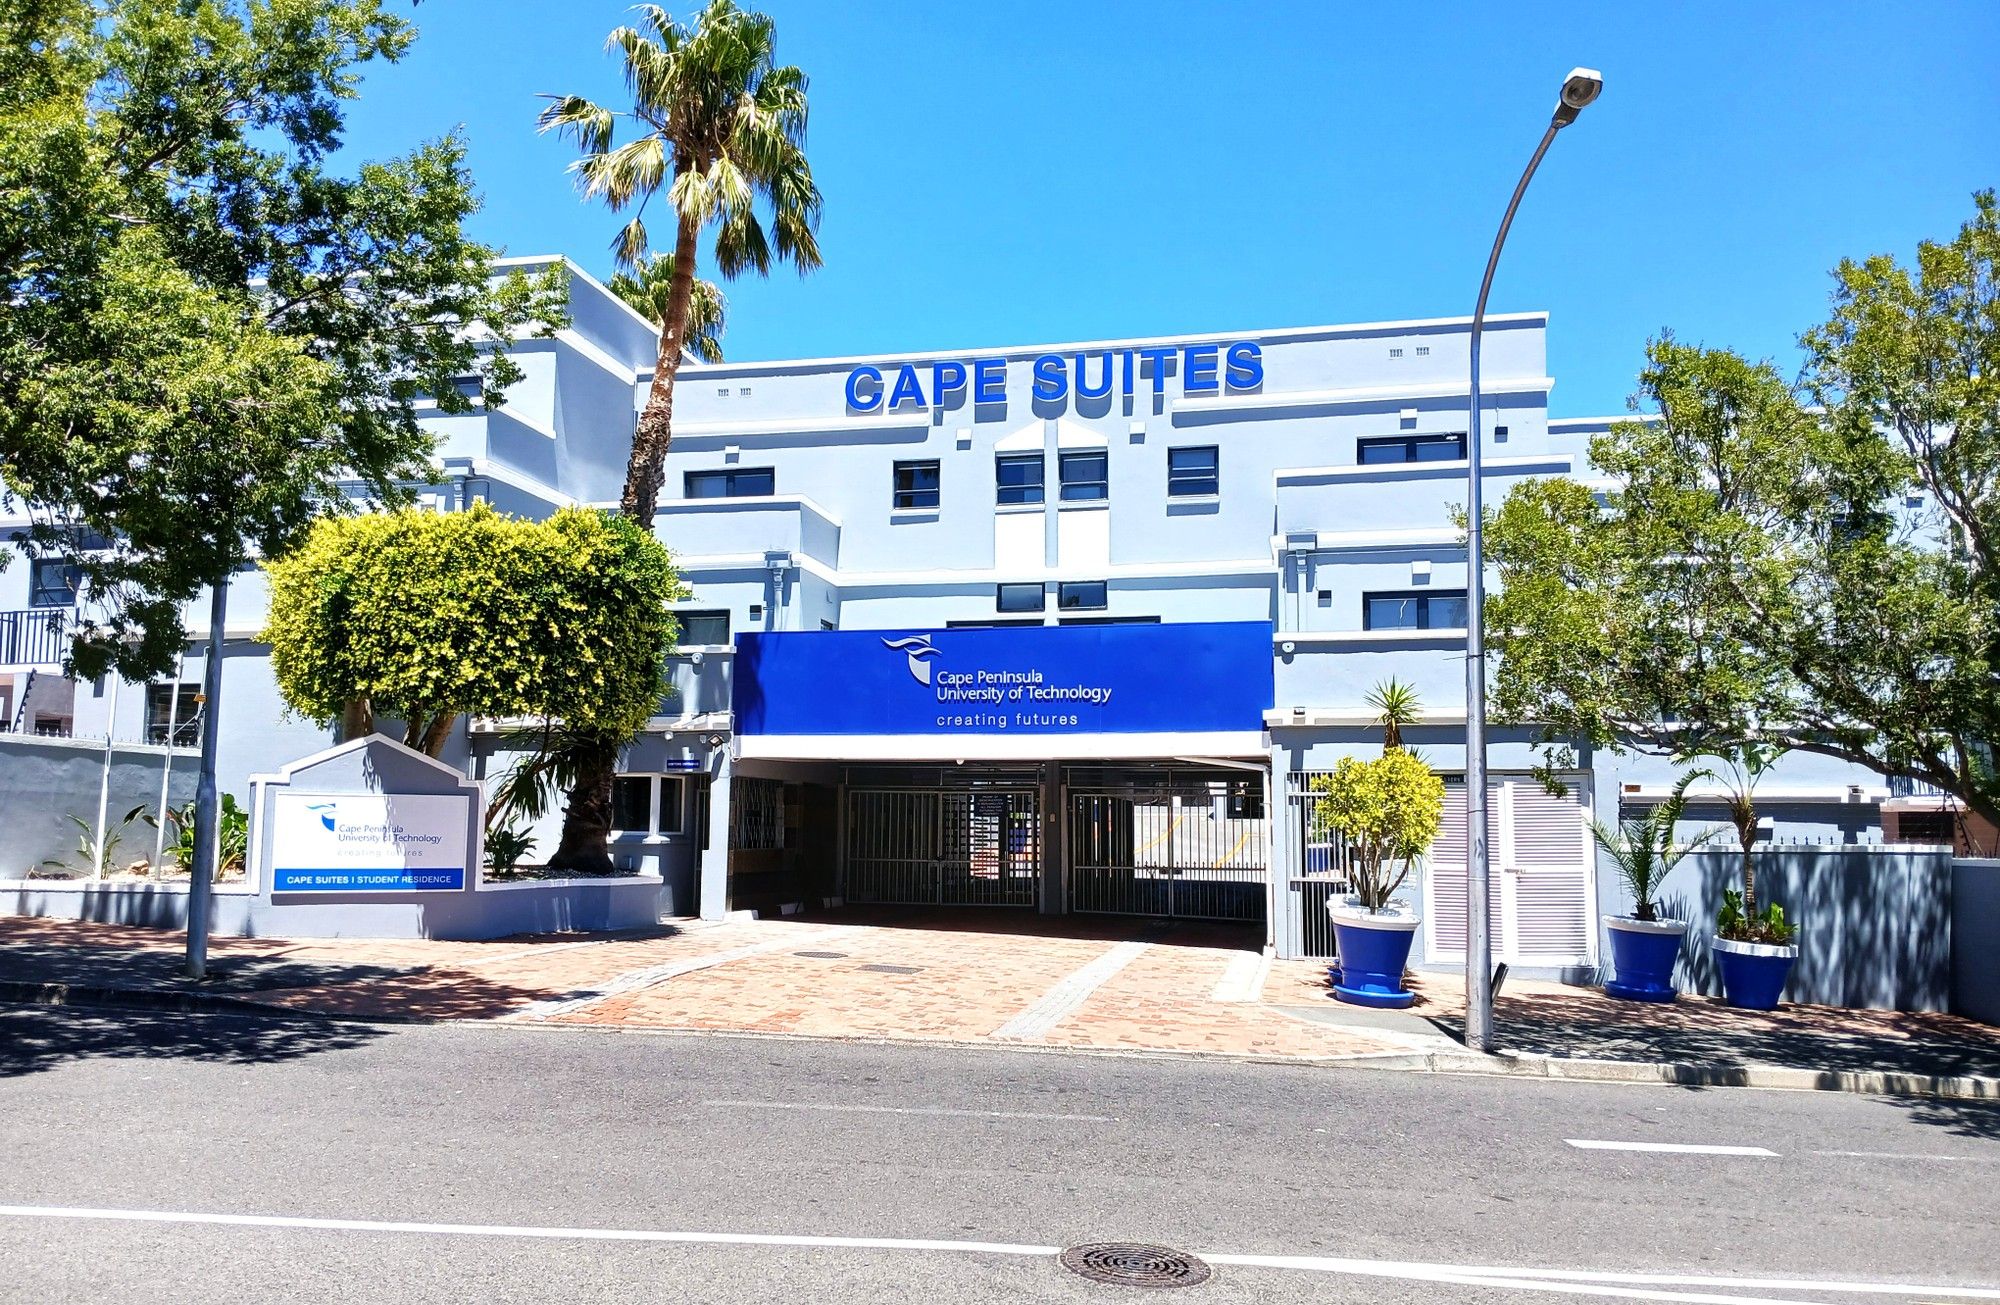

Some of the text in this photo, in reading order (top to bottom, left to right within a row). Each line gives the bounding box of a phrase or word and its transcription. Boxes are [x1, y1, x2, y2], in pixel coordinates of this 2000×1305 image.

[845, 341, 1264, 412] CAPE SUITES
[937, 669, 1043, 688] Cape Peninsula
[937, 684, 1112, 703] University of Technology
[936, 712, 1078, 728] creating futures
[338, 824, 361, 835] Cape
[338, 833, 381, 844] University
[393, 833, 442, 845] Technology
[386, 849, 424, 857] fures
[287, 875, 313, 884] CAPE
[315, 875, 349, 884] SUITES
[357, 875, 400, 884] STUDENT
[401, 875, 452, 884] RESIDENCE
